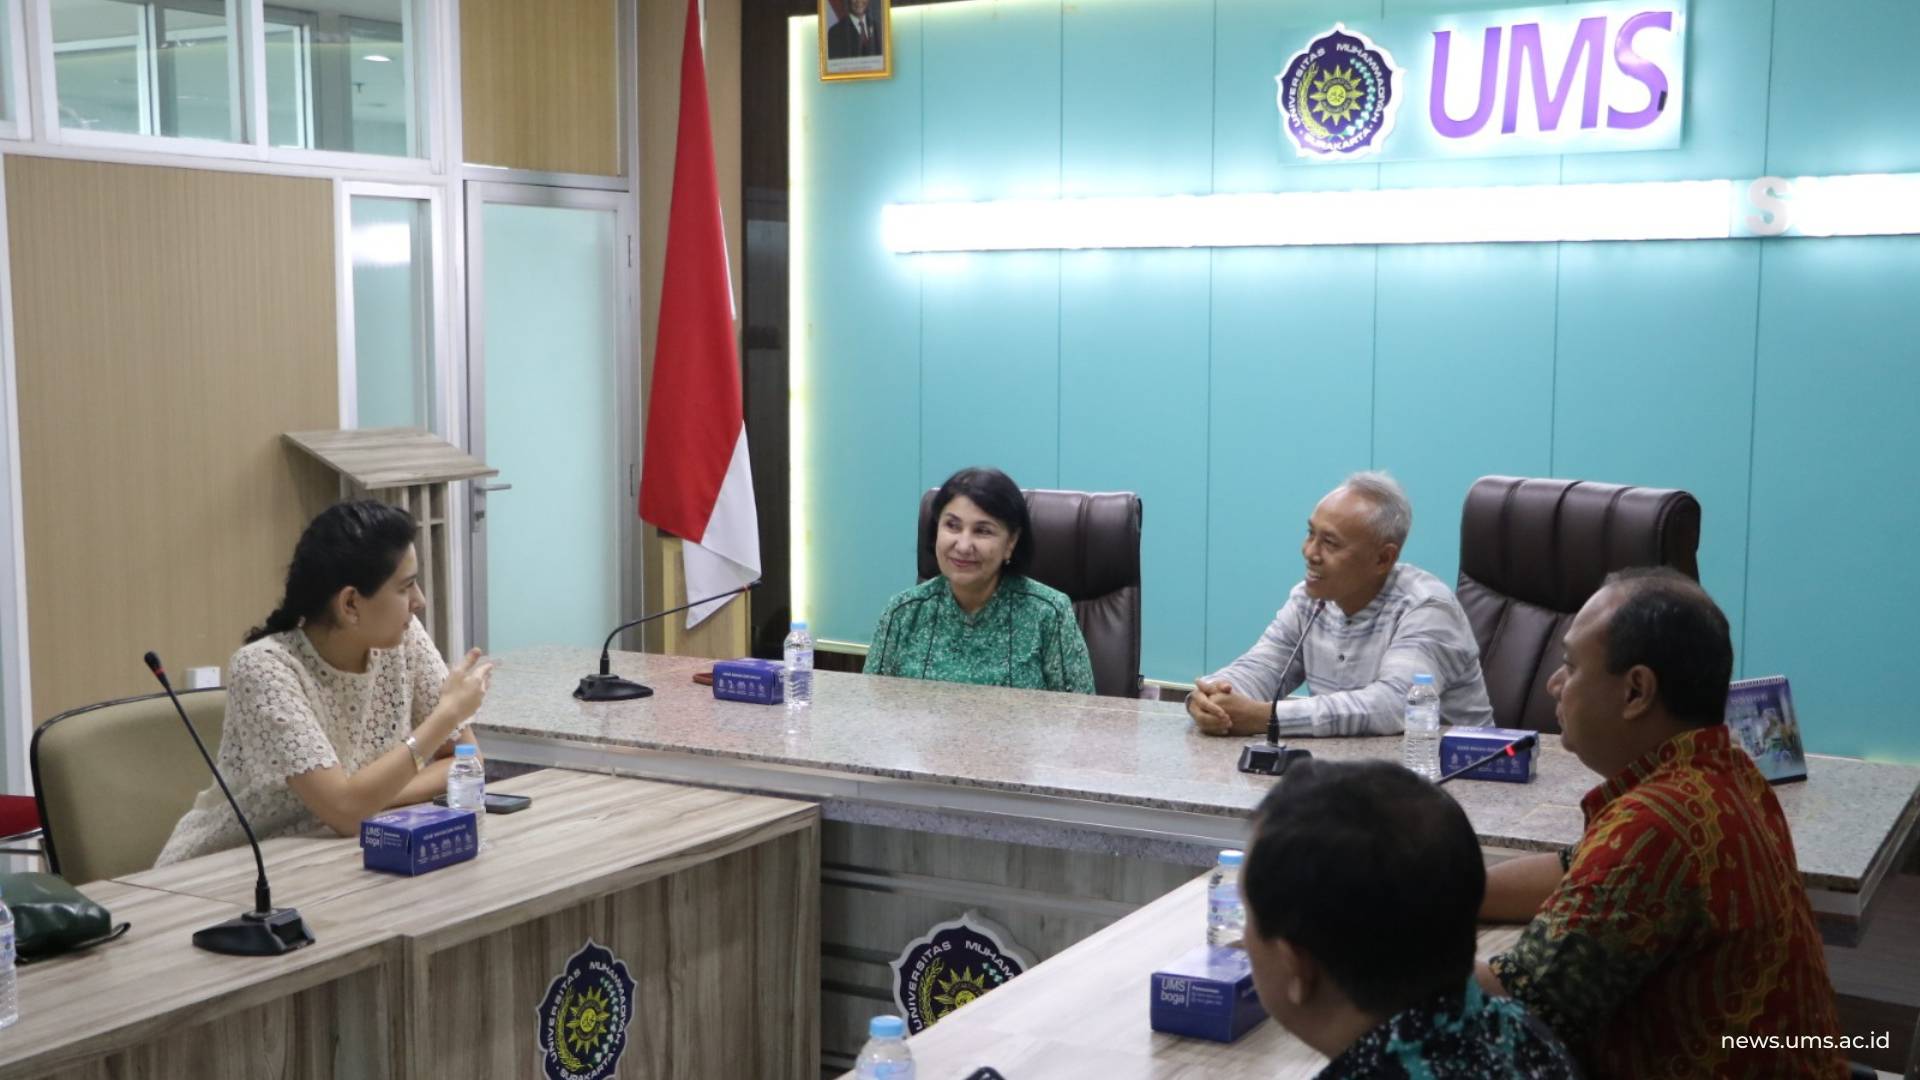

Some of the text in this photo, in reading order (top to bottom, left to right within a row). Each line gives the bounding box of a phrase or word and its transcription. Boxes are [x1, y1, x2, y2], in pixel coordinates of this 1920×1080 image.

[1288, 48, 1326, 128] UNIVERSITAS
[1336, 43, 1385, 122] MUHAMMADIYAH
[1429, 11, 1673, 138] UMS
[547, 961, 627, 1063] UNIVERSITAS MUHAMMADIYAH
[908, 940, 952, 1030] UNIVERSITAS
[1160, 990, 1185, 1005] boga
[1161, 978, 1185, 992] UMS
